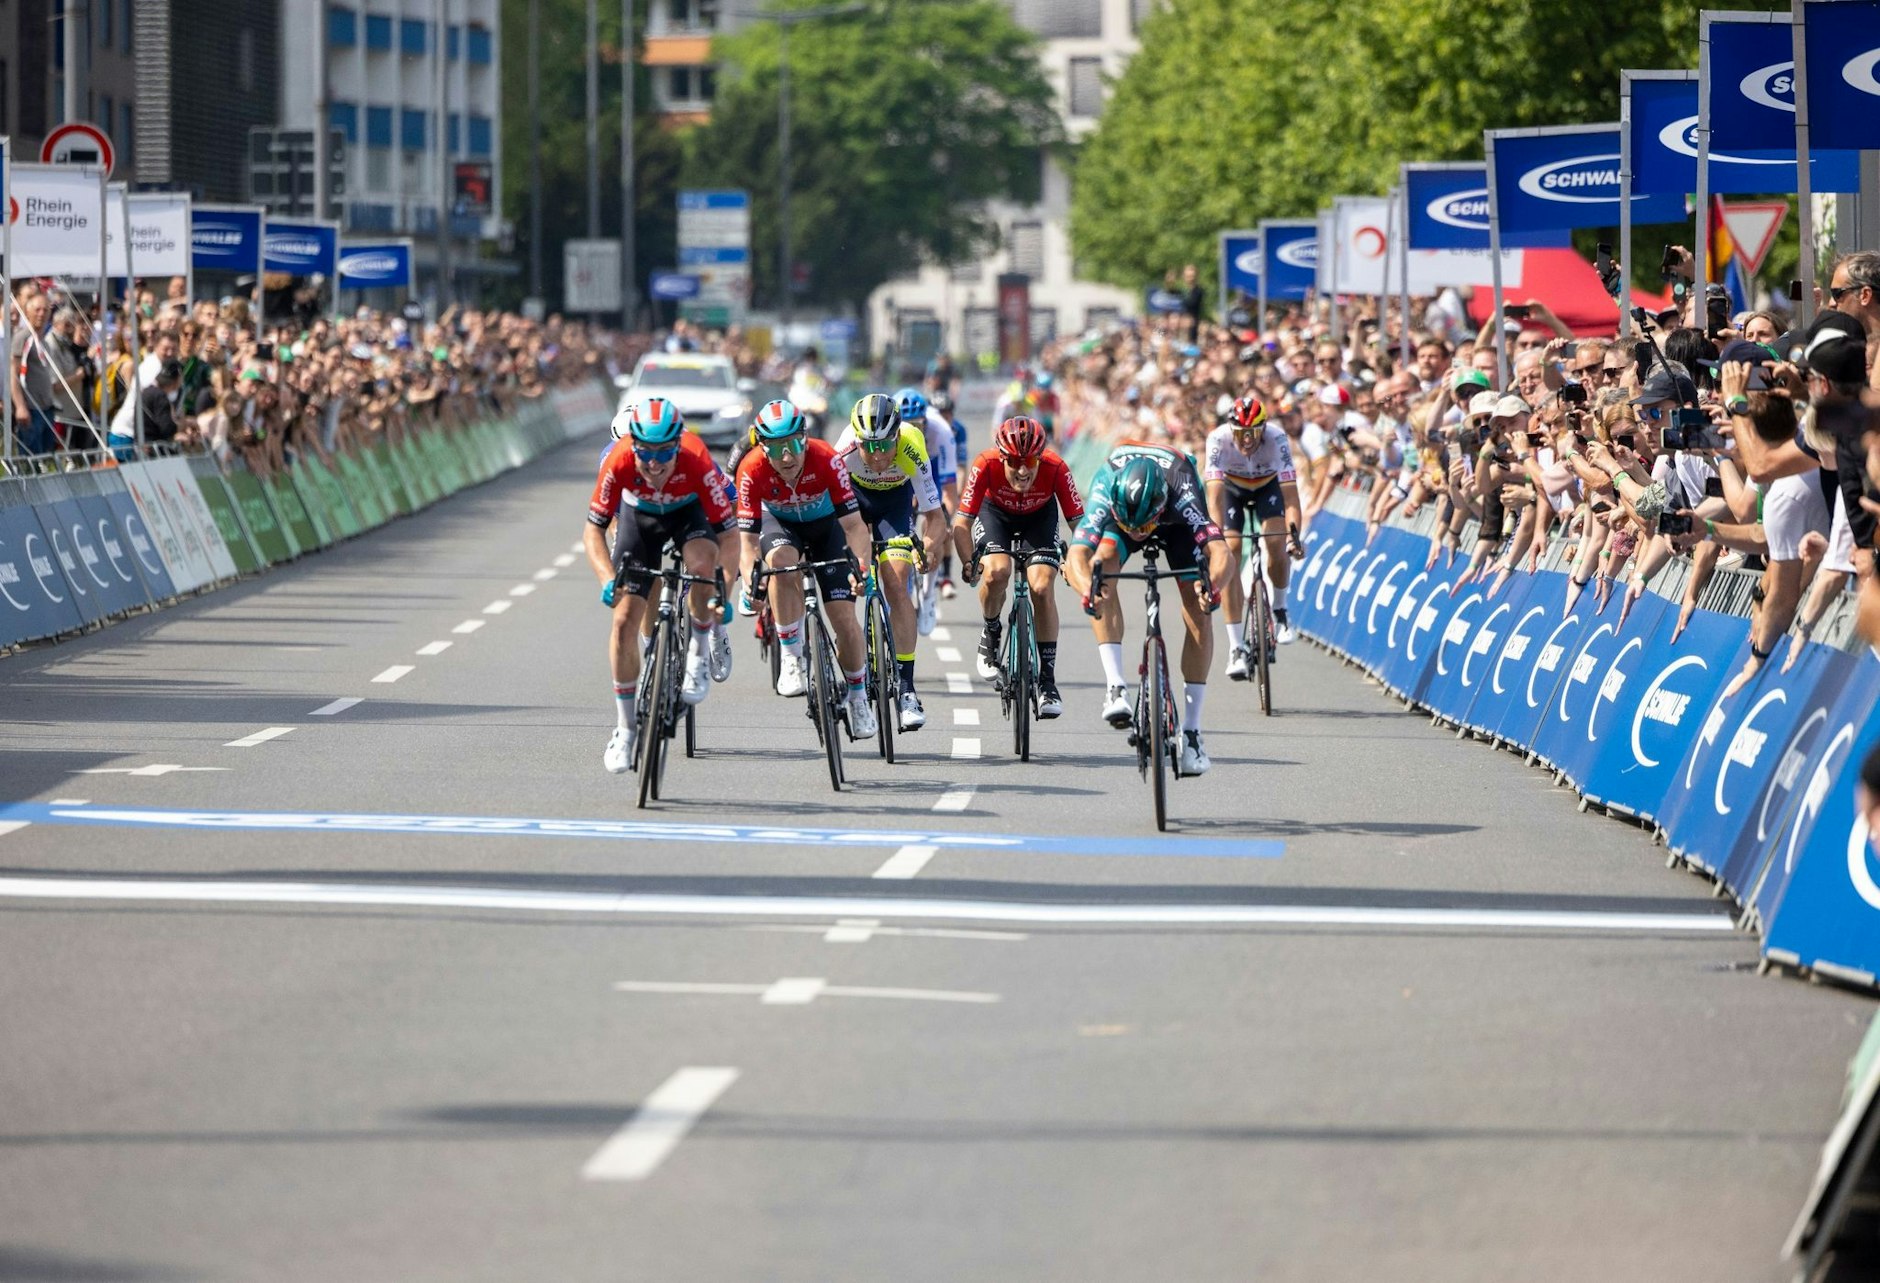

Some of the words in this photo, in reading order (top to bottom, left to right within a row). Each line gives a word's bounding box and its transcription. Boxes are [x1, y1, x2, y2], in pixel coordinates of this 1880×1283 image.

[1543, 170, 1621, 188] SCHWA
[26, 197, 72, 212] Rhein
[26, 213, 88, 230] Energie
[130, 226, 161, 239] hein
[130, 241, 175, 253] nergie
[739, 471, 754, 509] dstny
[961, 466, 981, 507] ARKEA
[1065, 471, 1083, 510] ARKEA
